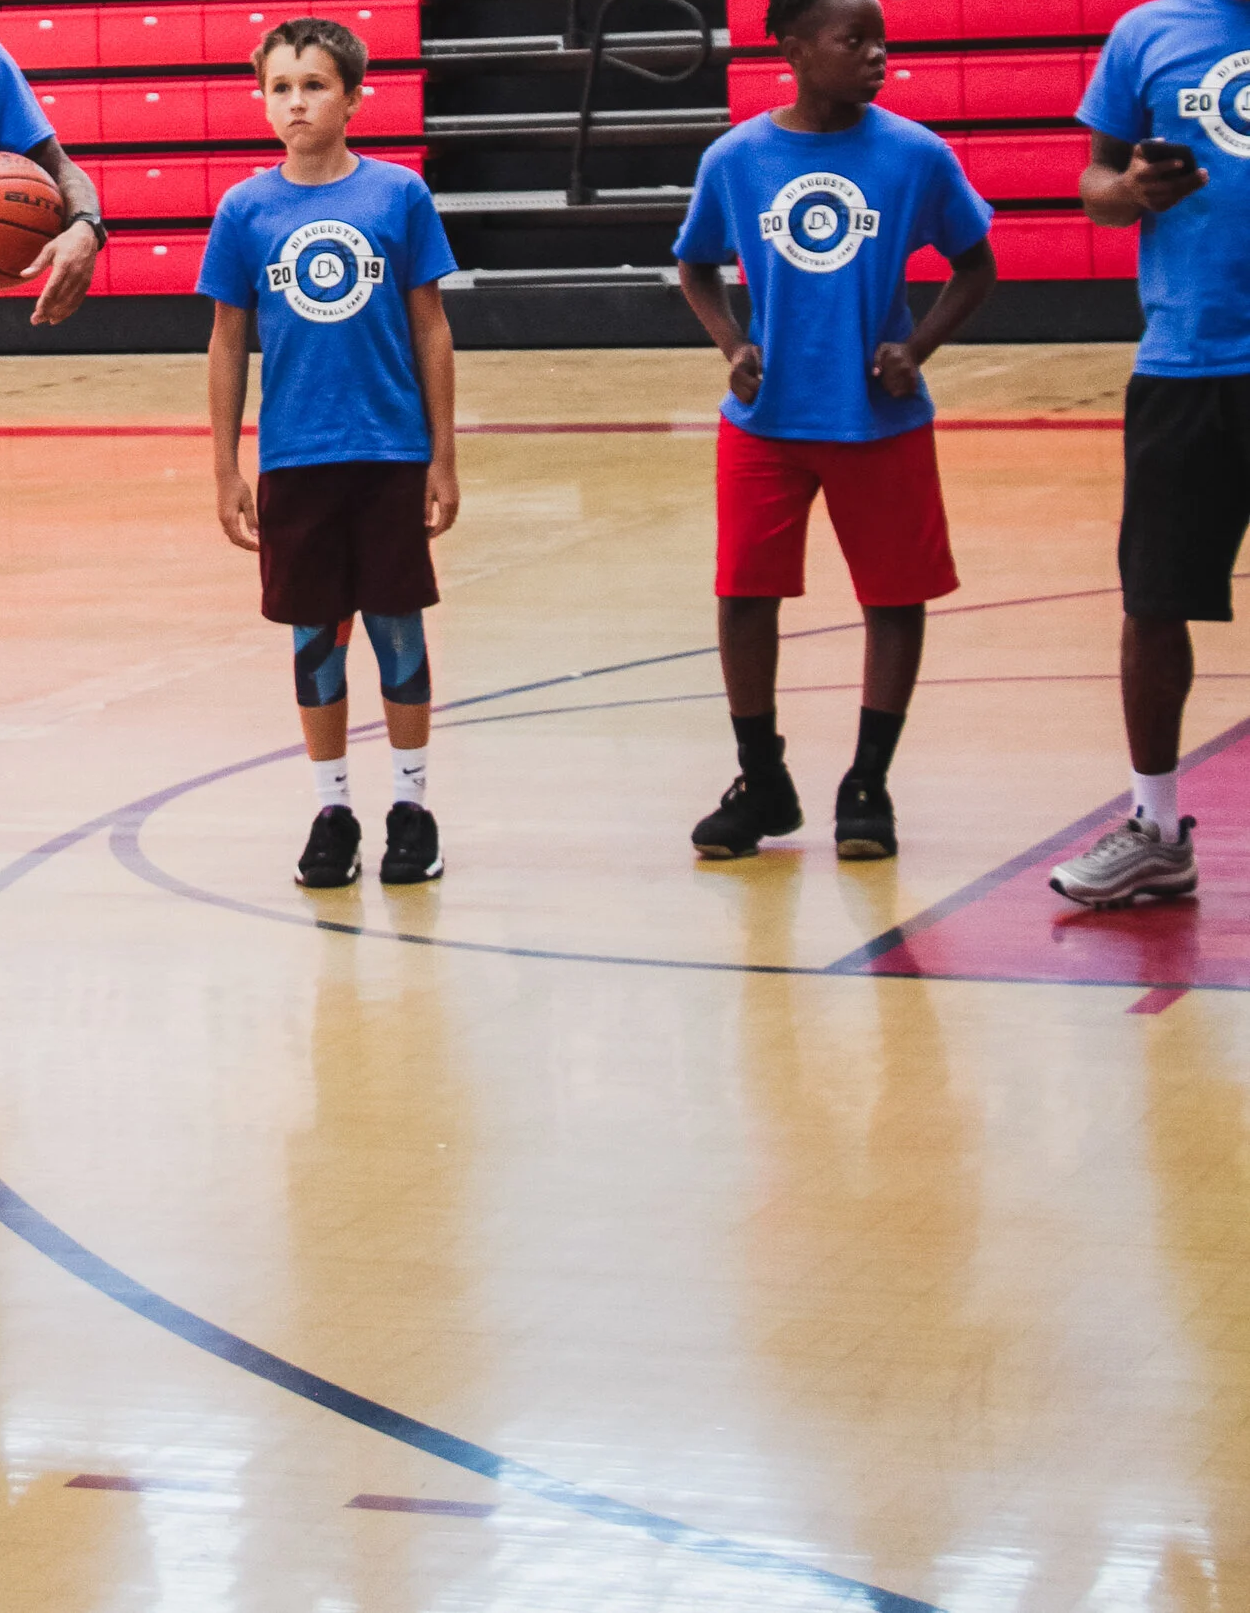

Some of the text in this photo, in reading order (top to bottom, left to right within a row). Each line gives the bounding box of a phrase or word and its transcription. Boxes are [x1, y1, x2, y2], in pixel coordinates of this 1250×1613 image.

[1185, 94, 1210, 111] 20
[764, 213, 874, 233] 20 19
[304, 225, 360, 245] AUGUSTIN
[272, 261, 380, 285] 20 19
